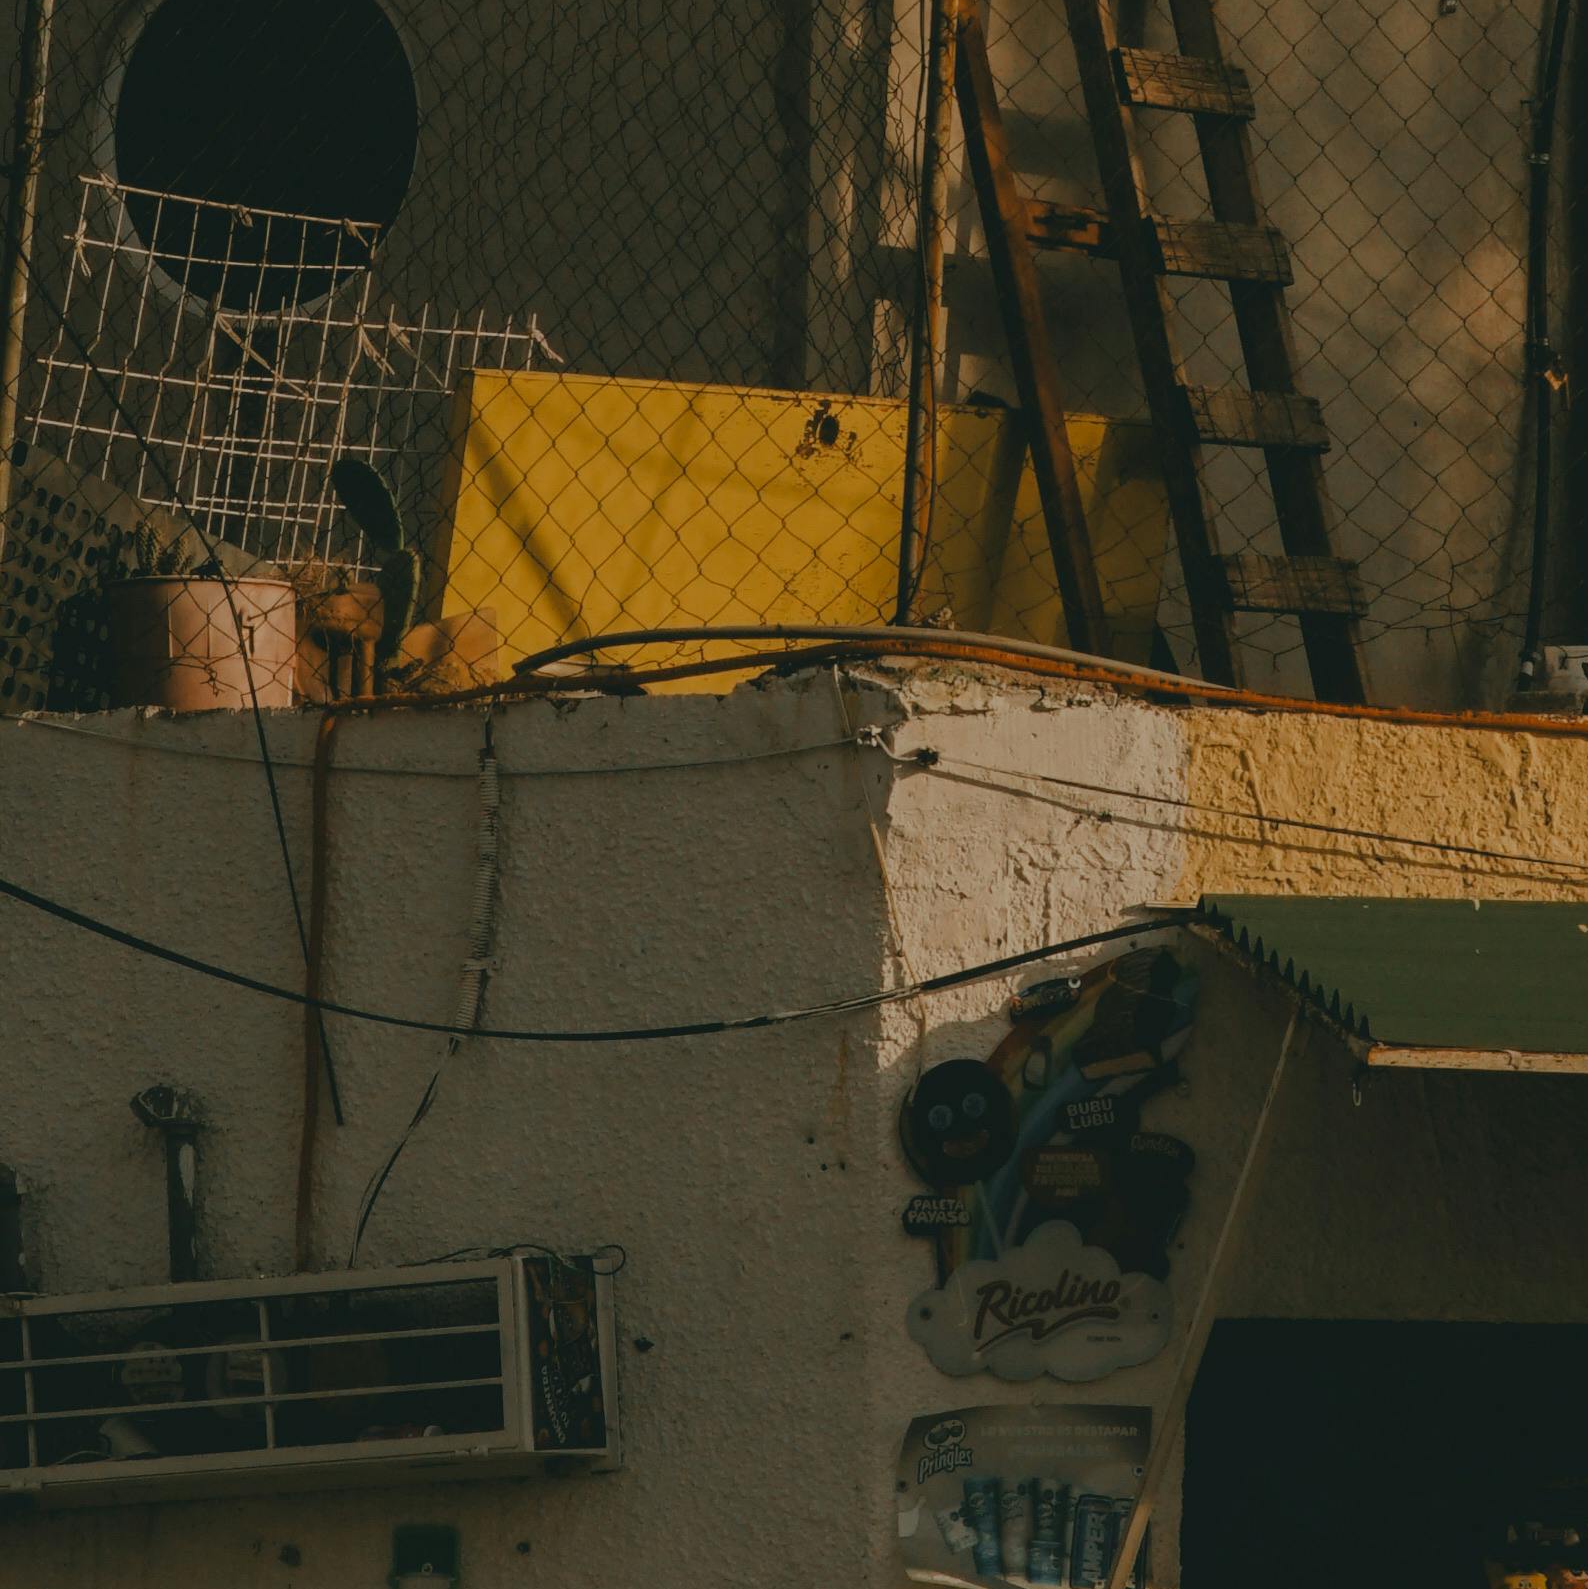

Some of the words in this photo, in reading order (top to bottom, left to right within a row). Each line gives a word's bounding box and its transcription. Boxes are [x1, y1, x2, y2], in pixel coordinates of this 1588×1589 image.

[1066, 1098, 1113, 1118] BUBU
[1069, 1111, 1115, 1130] LUBU
[912, 1198, 966, 1212] PALETA
[974, 1268, 1121, 1341] Ricolino
[916, 1445, 974, 1485] Pringles
